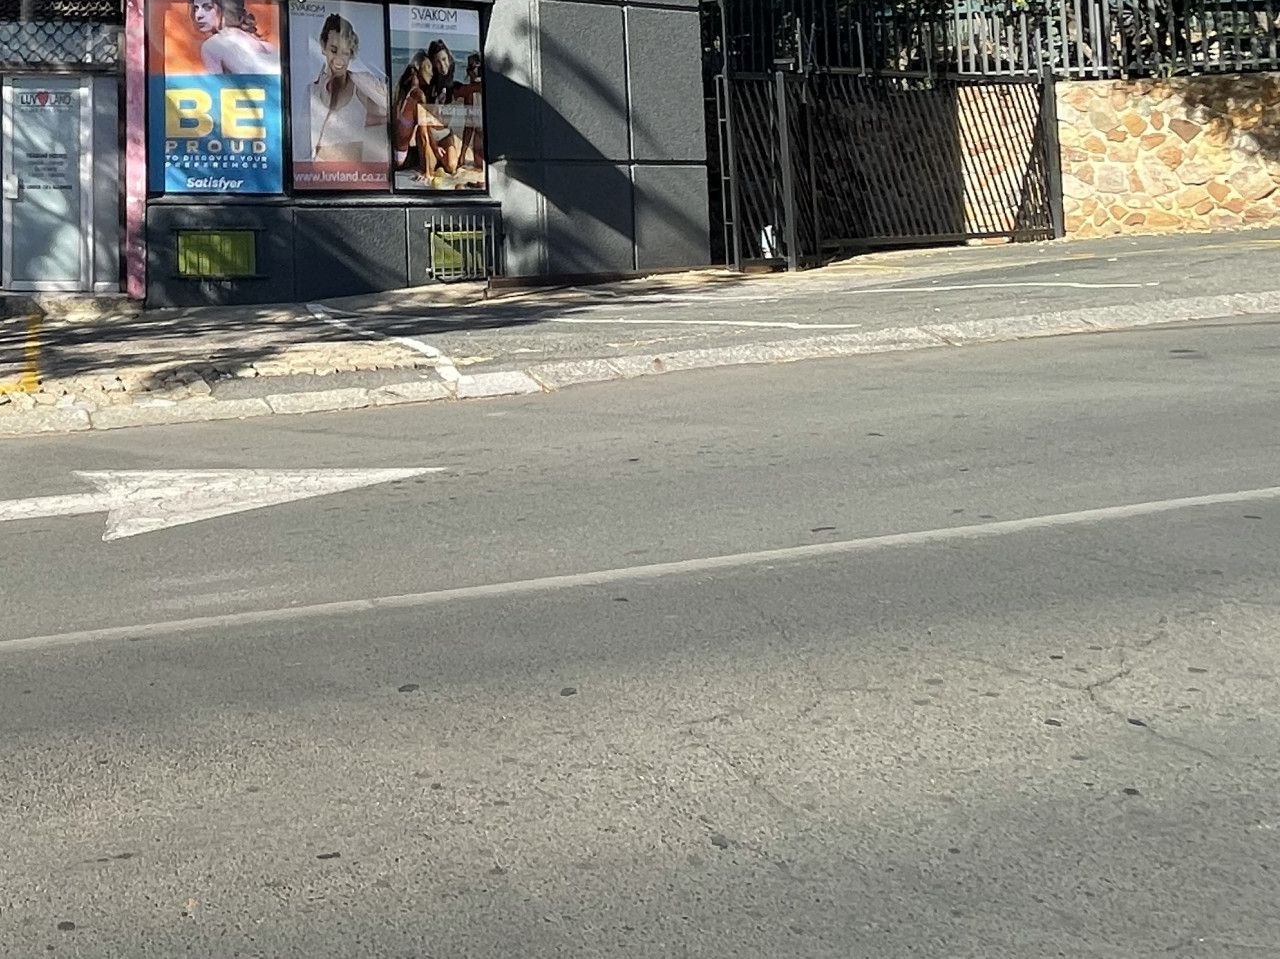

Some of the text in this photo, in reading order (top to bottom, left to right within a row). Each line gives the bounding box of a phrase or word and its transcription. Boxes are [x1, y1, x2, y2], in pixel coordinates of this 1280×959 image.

[411, 7, 458, 22] SVAKOM
[20, 93, 37, 105] LUV
[165, 88, 267, 139] BE
[165, 140, 267, 154] PROUD
[186, 176, 244, 190] Satisfyer
[294, 169, 388, 183] www.luvland.co.za
